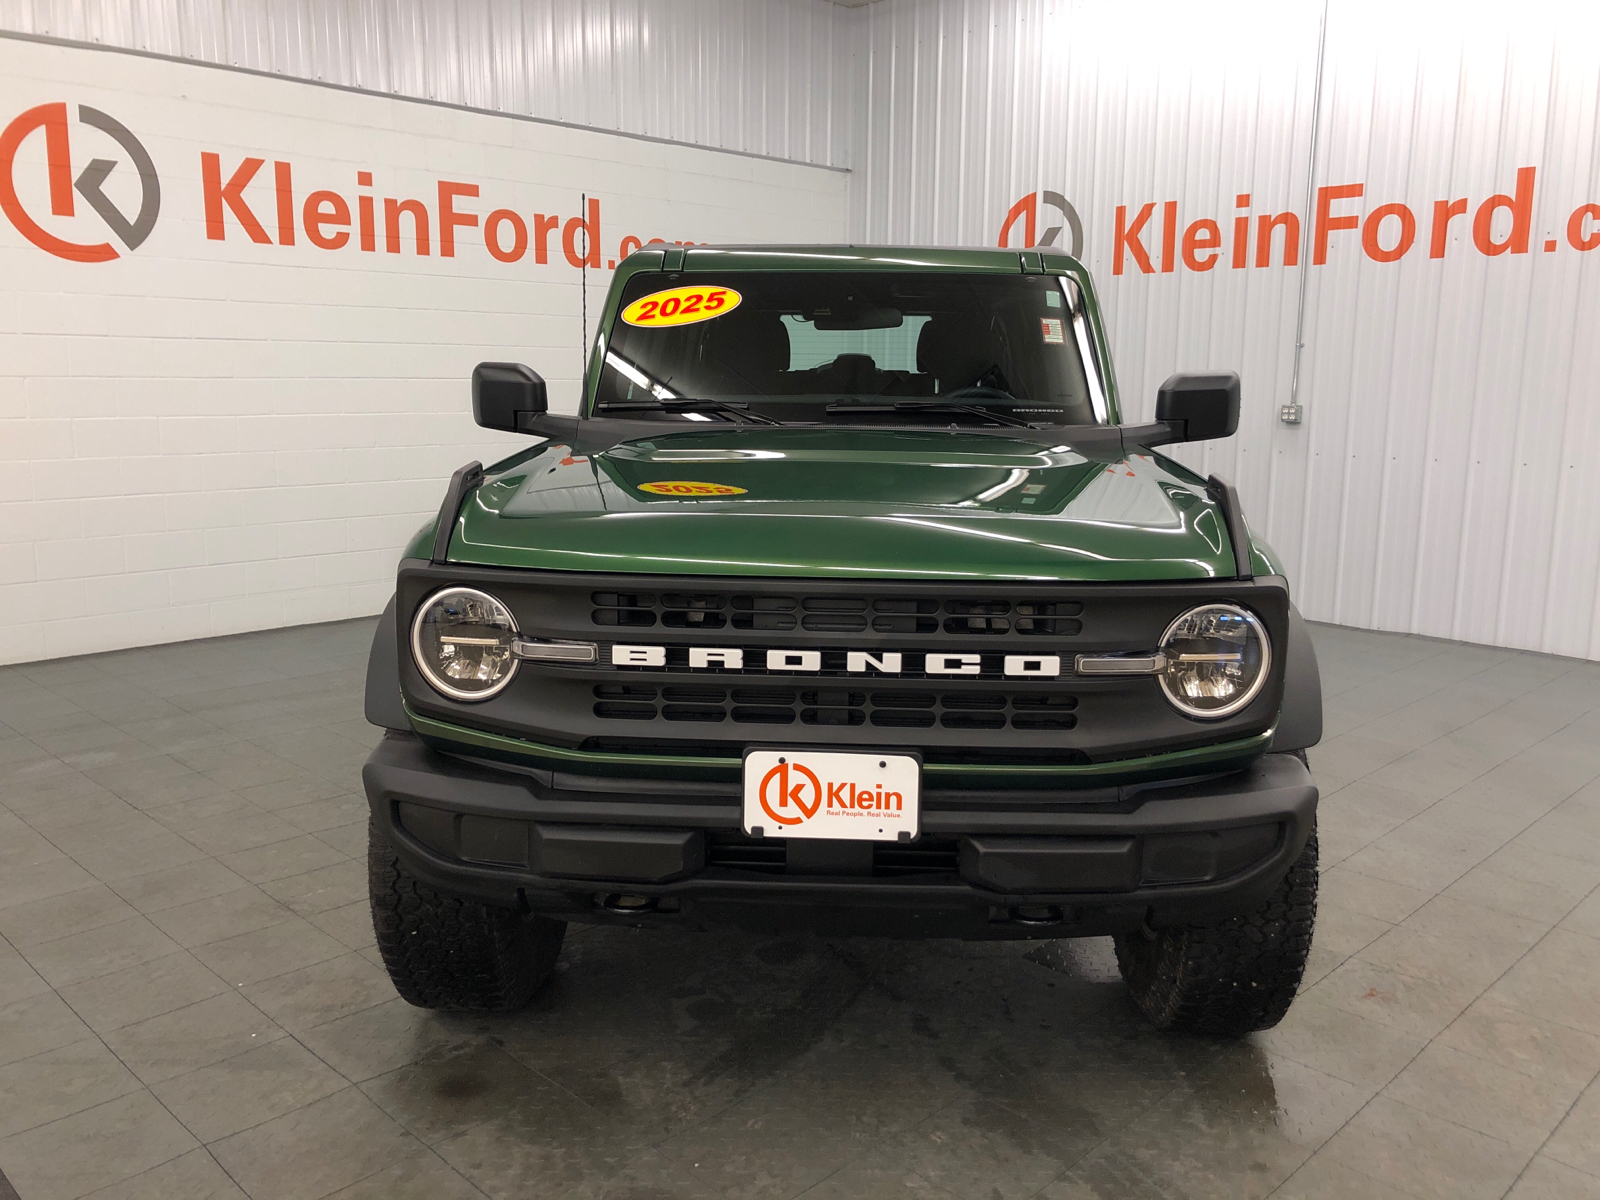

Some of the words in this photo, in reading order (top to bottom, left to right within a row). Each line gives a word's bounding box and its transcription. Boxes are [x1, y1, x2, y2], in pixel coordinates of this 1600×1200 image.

[201, 152, 708, 270] KleinFord.c
[635, 290, 727, 322] 2025
[612, 644, 1061, 677] BRONCO
[826, 782, 903, 811] Klein
[842, 810, 865, 818] People.
